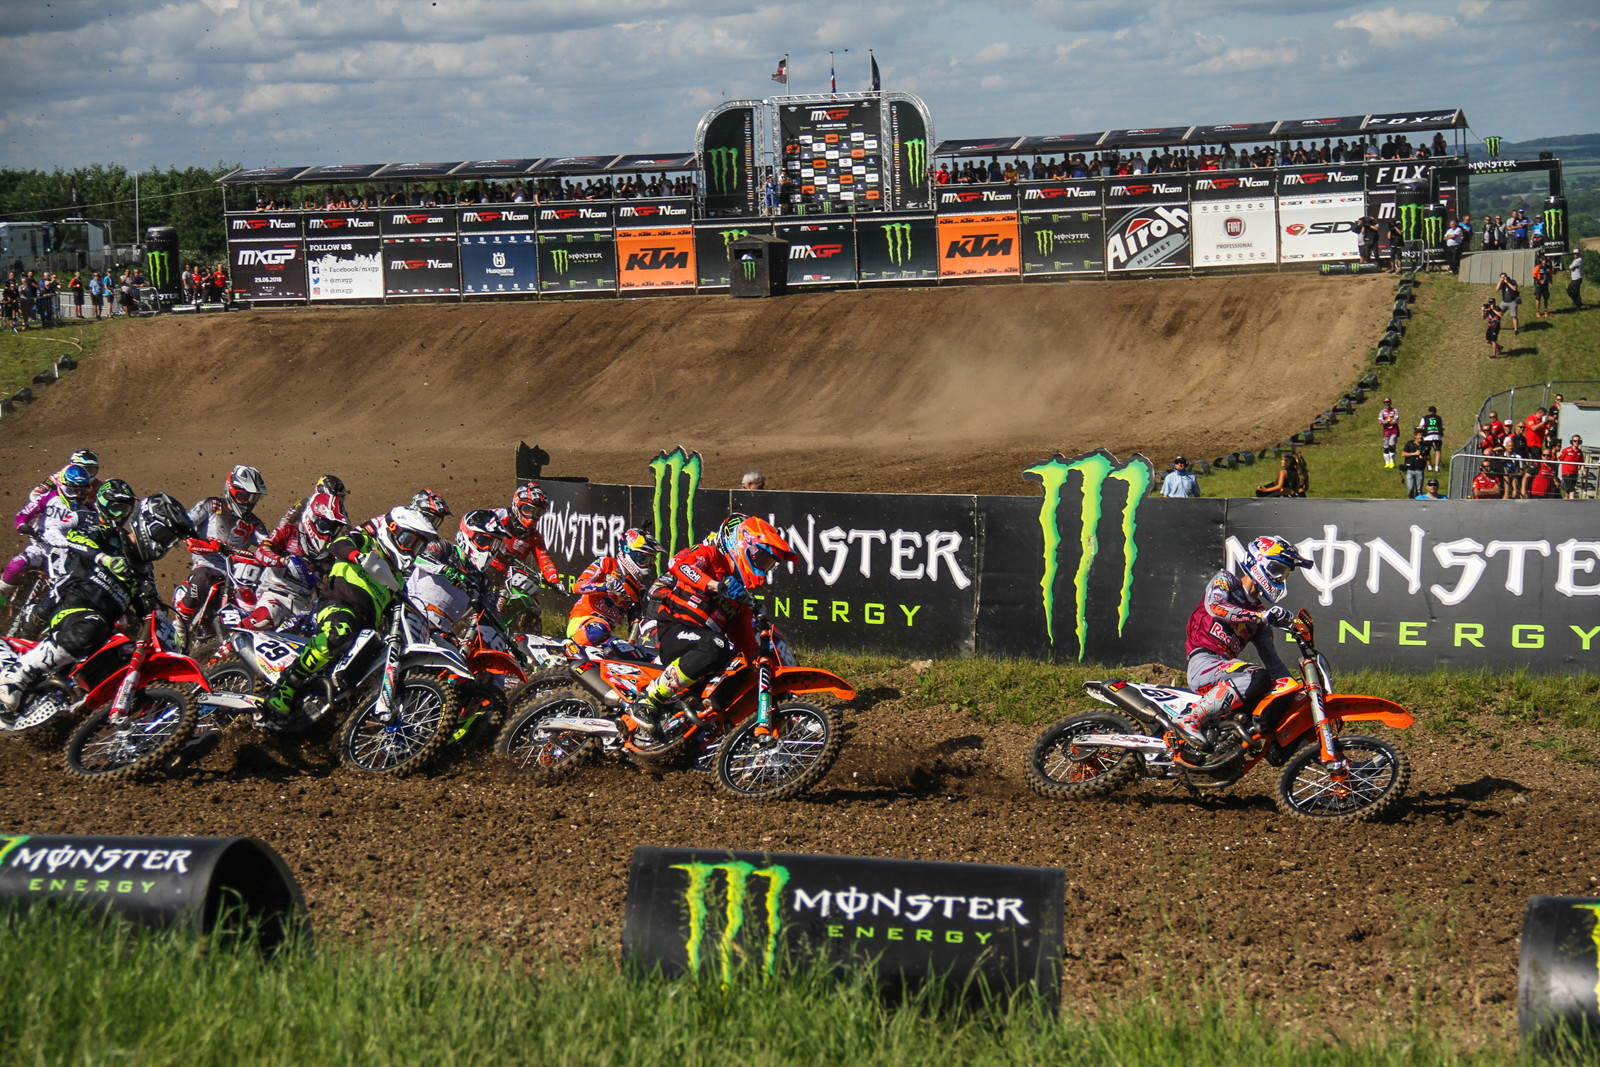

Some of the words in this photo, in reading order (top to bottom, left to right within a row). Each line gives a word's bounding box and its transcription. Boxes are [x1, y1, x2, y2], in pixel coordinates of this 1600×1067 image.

[1376, 165, 1426, 183] FOX
[1468, 159, 1517, 171] MONSTER
[1227, 221, 1241, 232] FIAT
[1308, 221, 1354, 235] SID
[945, 234, 1013, 258] KTM
[1107, 206, 1189, 270] Airoh
[238, 249, 296, 266] MXGP
[625, 247, 689, 271] KTM
[789, 244, 843, 260] MXGP
[1136, 241, 1172, 265] HELMET
[767, 513, 971, 590] NSTER
[233, 562, 261, 581] 10
[1285, 620, 1600, 650] NERGY
[256, 640, 290, 662] 29
[12, 845, 192, 874] MONSTER
[28, 878, 156, 893] ENERGY
[793, 886, 1030, 925] MONSTER
[828, 924, 993, 945] ENERGY
